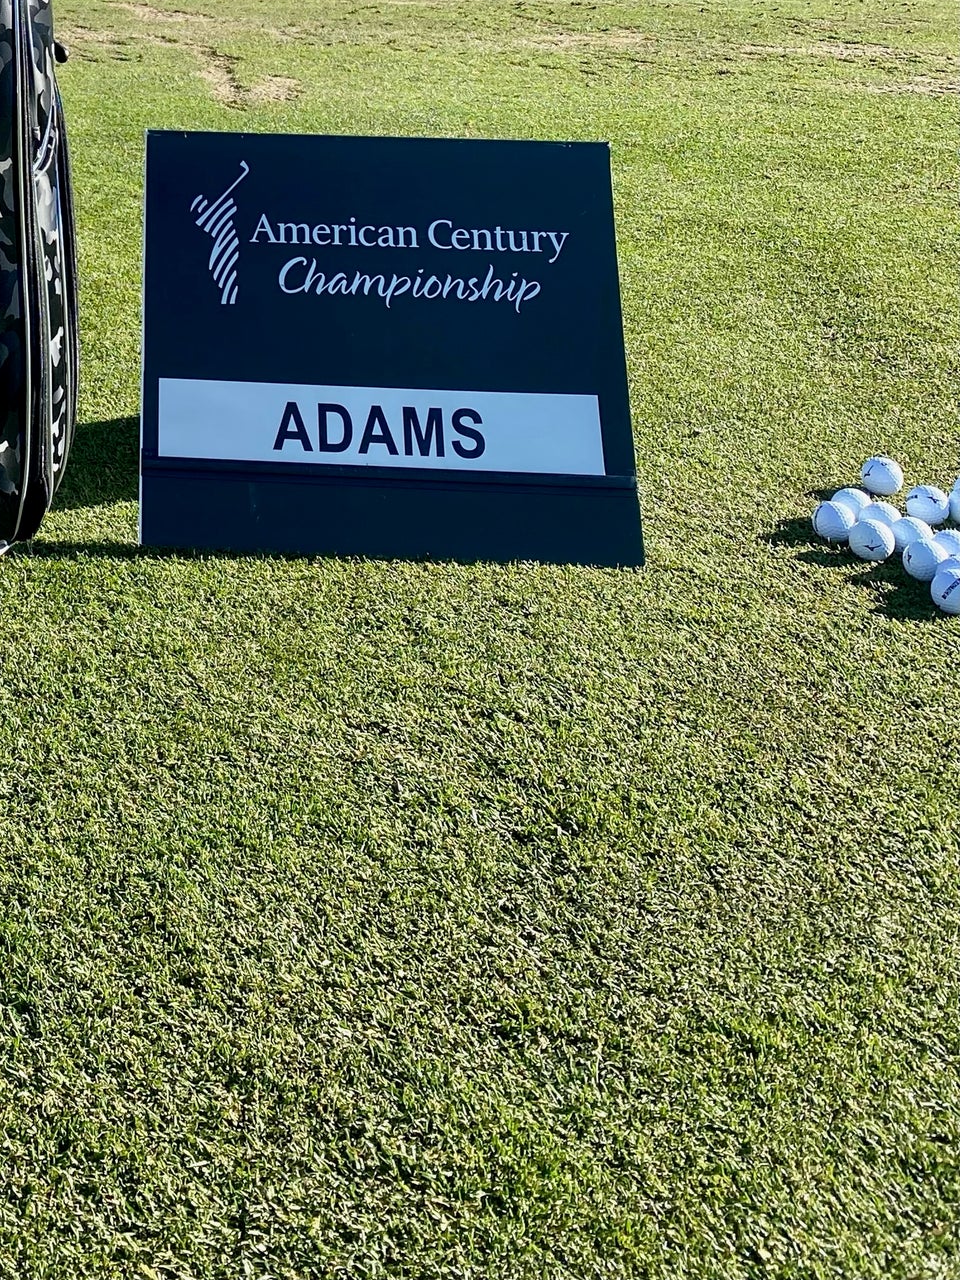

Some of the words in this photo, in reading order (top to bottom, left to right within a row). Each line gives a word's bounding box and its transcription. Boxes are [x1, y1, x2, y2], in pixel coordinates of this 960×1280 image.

[249, 214, 419, 249] American
[427, 220, 569, 263] Century
[278, 257, 542, 313] Championship
[272, 401, 486, 459] ADAMS
